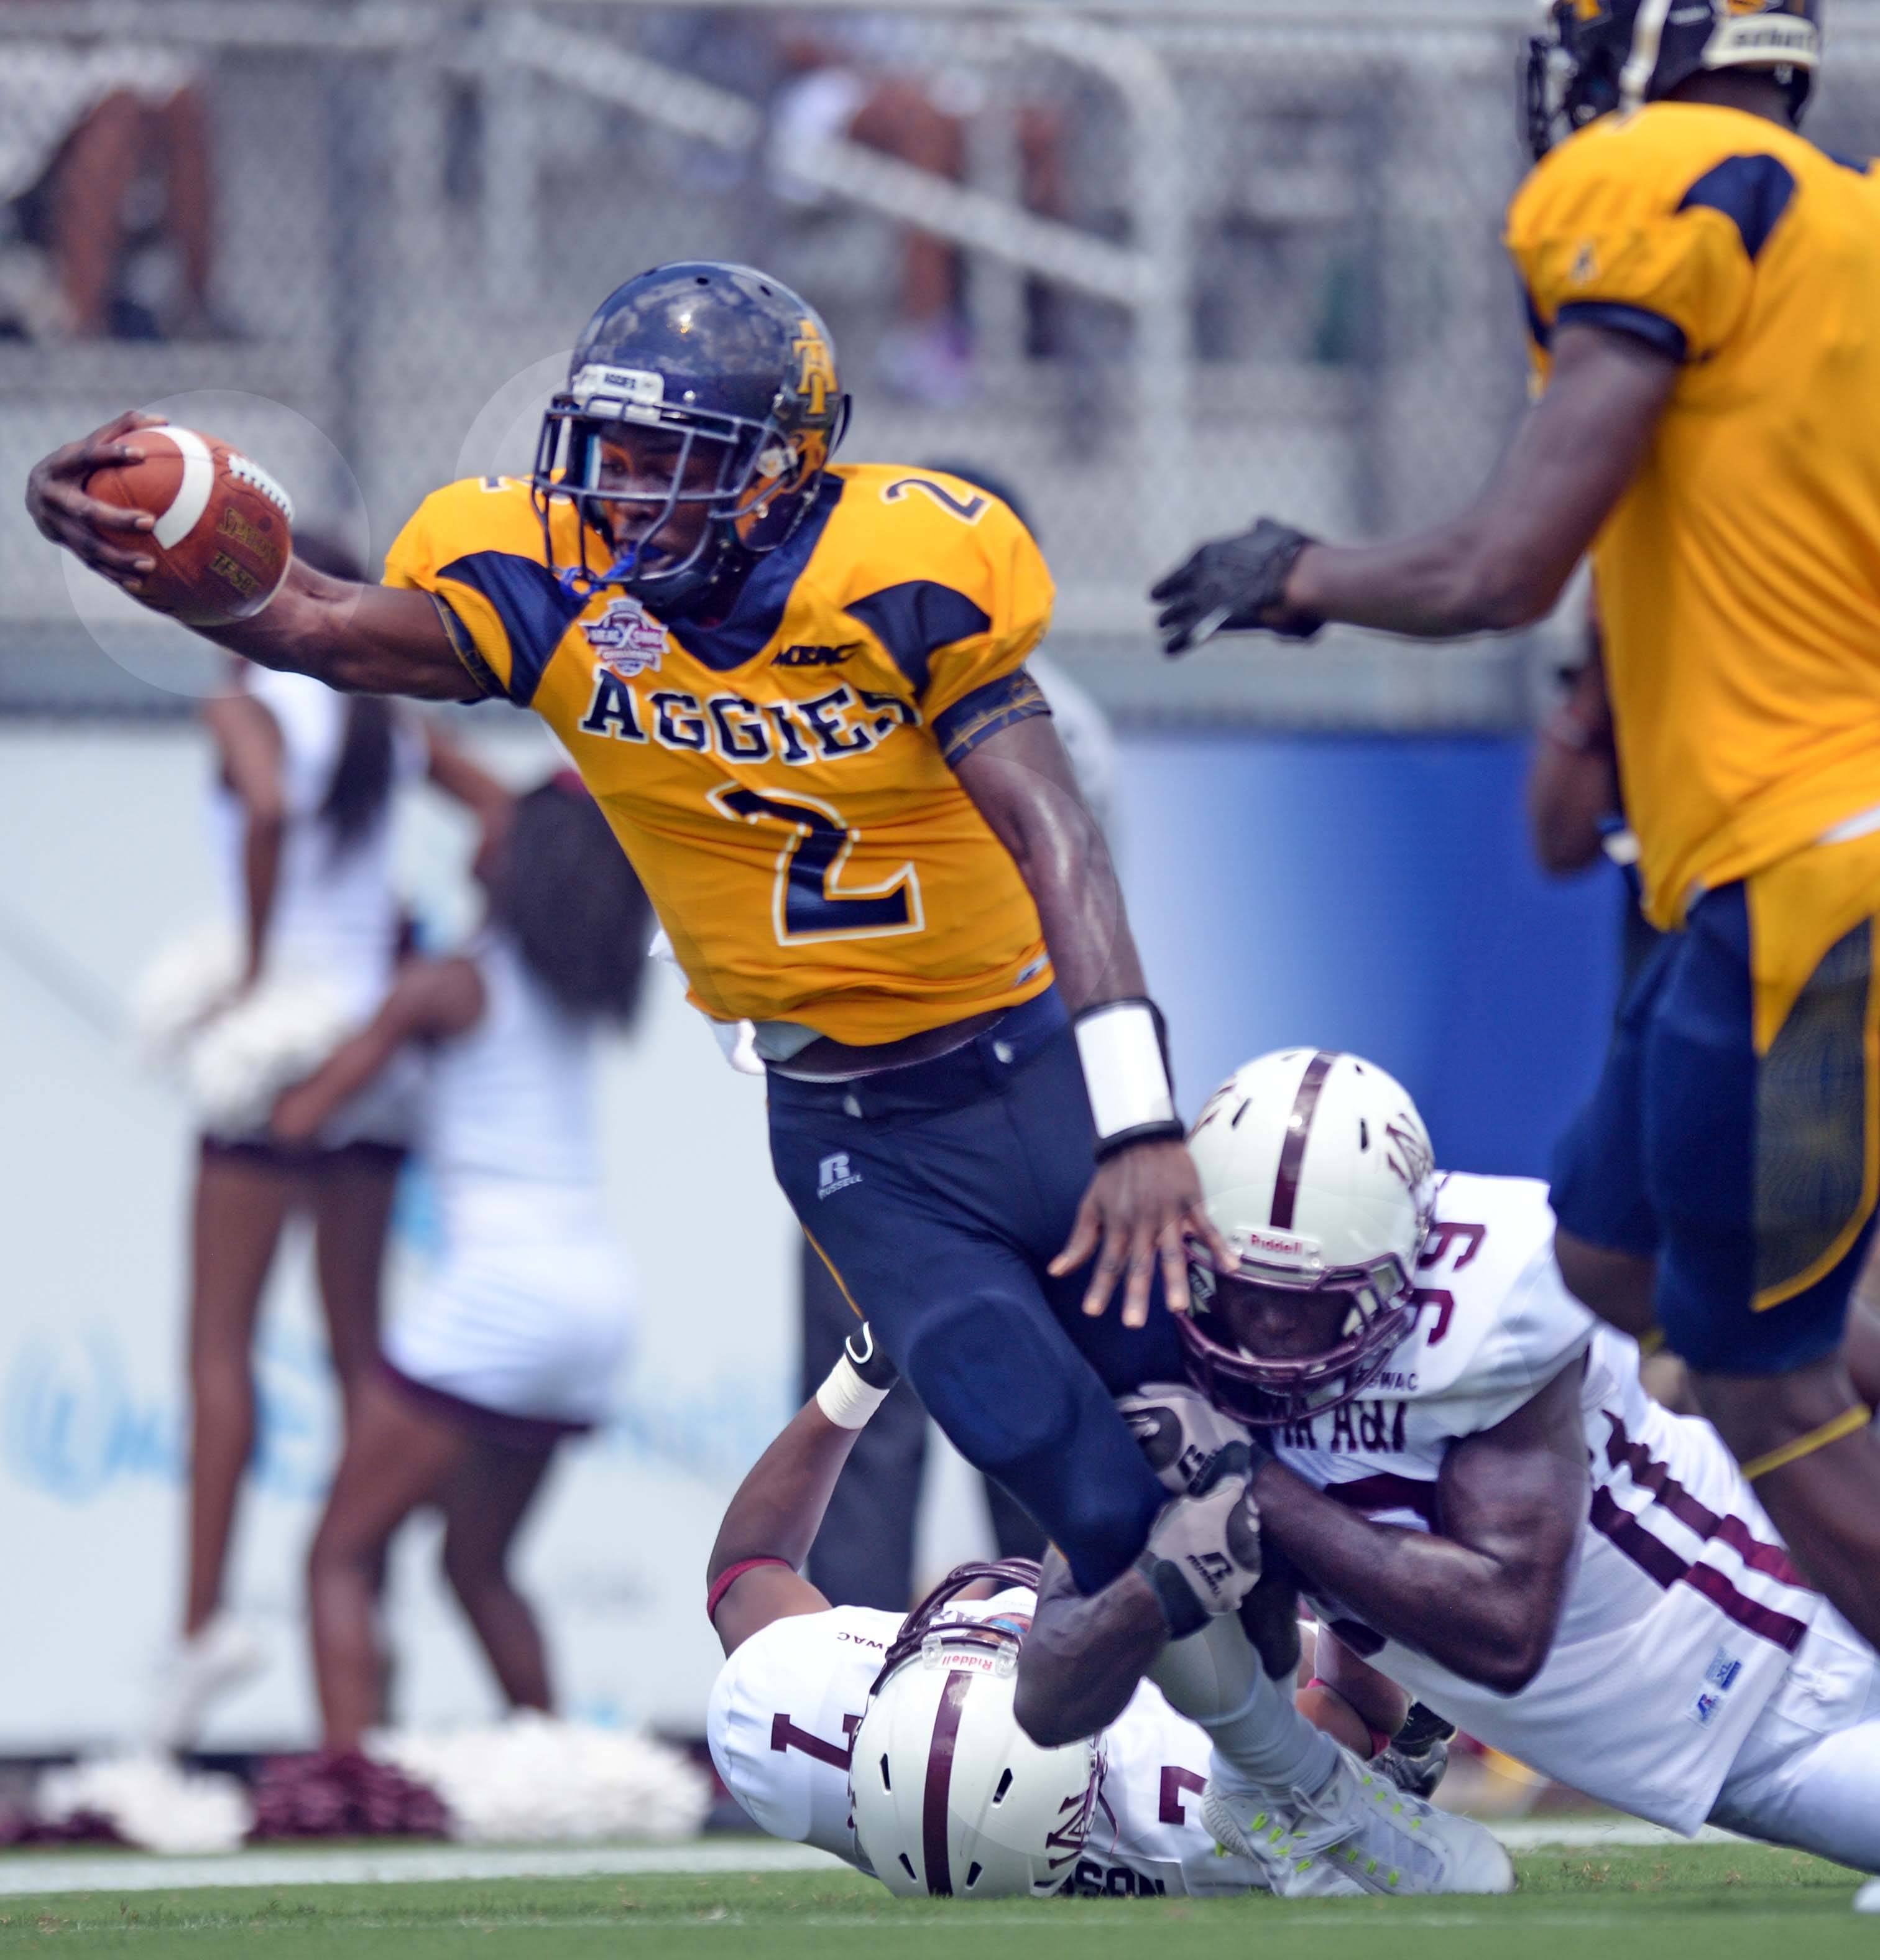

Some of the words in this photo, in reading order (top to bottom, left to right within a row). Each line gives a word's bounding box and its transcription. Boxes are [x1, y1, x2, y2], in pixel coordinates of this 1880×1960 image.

[880, 477, 993, 527] 2
[706, 779, 925, 947] 2
[837, 1632, 890, 1650] WAC
[942, 1655, 993, 1671] Riddell
